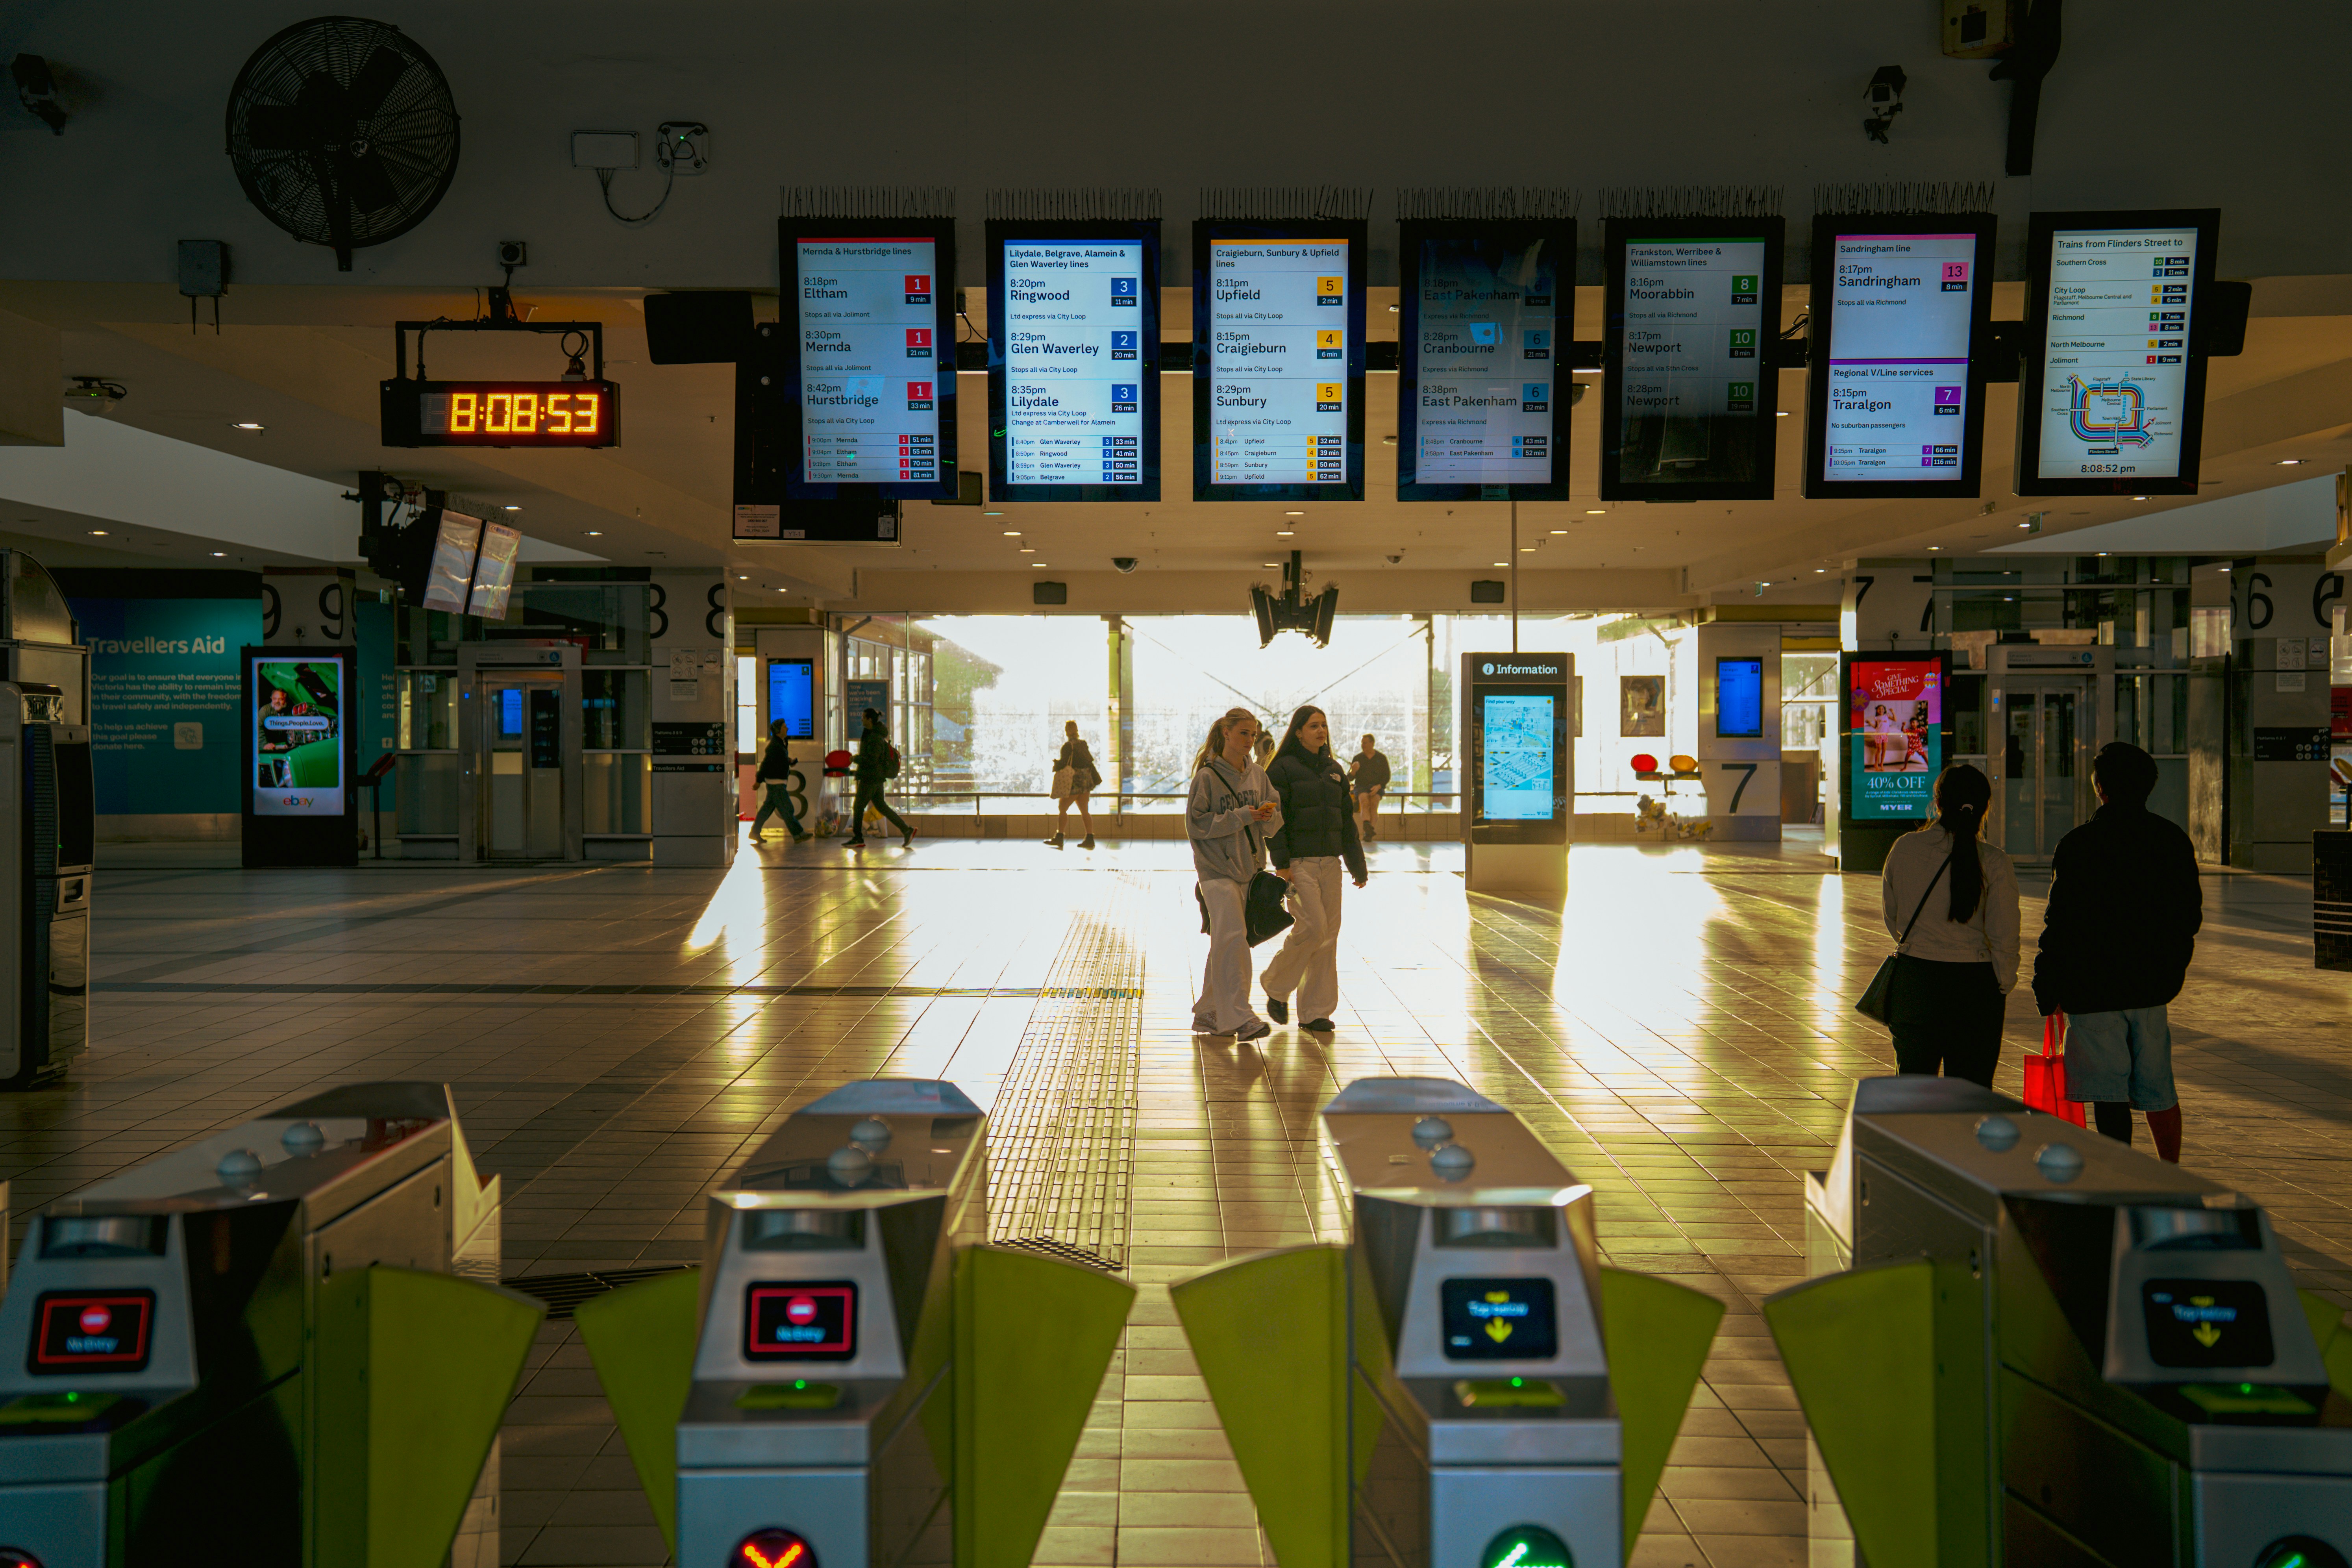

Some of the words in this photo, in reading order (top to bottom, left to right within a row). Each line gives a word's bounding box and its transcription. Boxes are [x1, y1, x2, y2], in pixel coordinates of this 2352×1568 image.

[2144, 239, 2172, 247] Street
[843, 247, 891, 257] Hurstbridge
[1010, 250, 1044, 259] Lilydale,
[1045, 250, 1083, 259] Belgrave,
[1216, 249, 1264, 258] Craigieburn,
[1266, 249, 1300, 258] Sunbury
[1310, 249, 1339, 258] Upfield
[1840, 245, 1894, 254] Sandringham
[1030, 260, 1068, 270] Waverley
[1839, 265, 1872, 275] 8:17pm
[1948, 265, 1962, 277] 13
[804, 277, 838, 287] 8:18pm
[914, 278, 921, 290] 1
[1010, 279, 1045, 289] 8:20pm
[1120, 281, 1128, 292] 3
[1216, 278, 1248, 289] 8:11pm
[1327, 280, 1334, 291] 5
[1630, 278, 1664, 288] 8:16pm
[1741, 278, 1749, 290] 8
[1839, 275, 1921, 289] Sandringham
[804, 288, 848, 298] Eltham
[1010, 290, 1070, 303] Ringwood
[1216, 289, 1260, 302] Upfield
[1630, 288, 1694, 299] Moorabbin
[1423, 332, 1458, 342] 8:28pm
[1533, 333, 1541, 344] 6
[1011, 344, 1038, 354] Glen
[1042, 344, 1099, 356] Waverley
[1216, 342, 1286, 356] Craigieburn
[1423, 342, 1495, 354] Cranbourne
[1628, 342, 1682, 354] Newport
[1834, 369, 1869, 378] Regional
[807, 383, 841, 394] 8:42pm
[1423, 385, 1457, 396] 8:38pm
[1833, 389, 1867, 399] 8:15pm
[807, 394, 879, 407] Hurstbridge
[1217, 396, 1267, 409] Sunbury
[1423, 396, 1450, 406] East
[1454, 396, 1517, 406] Pakenham
[1833, 399, 1891, 412] Traralgon
[451, 394, 598, 432] 8:08:53
[2081, 464, 2118, 473] 8:08:52
[2248, 573, 2274, 629] 6
[319, 584, 343, 640] 9
[86, 636, 189, 654] Travellers
[192, 635, 225, 654] Aid
[1497, 664, 1557, 674] Information
[1887, 673, 1901, 681] GIVE
[157, 683, 183, 692] ability
[1871, 676, 1919, 693] SOMETHING
[1876, 684, 1909, 698] SPECIAL
[129, 733, 157, 741] please
[1721, 763, 1758, 813] 7
[1867, 777, 1894, 789] 40%
[1897, 776, 1925, 788] OFF
[281, 795, 314, 808] ebay
